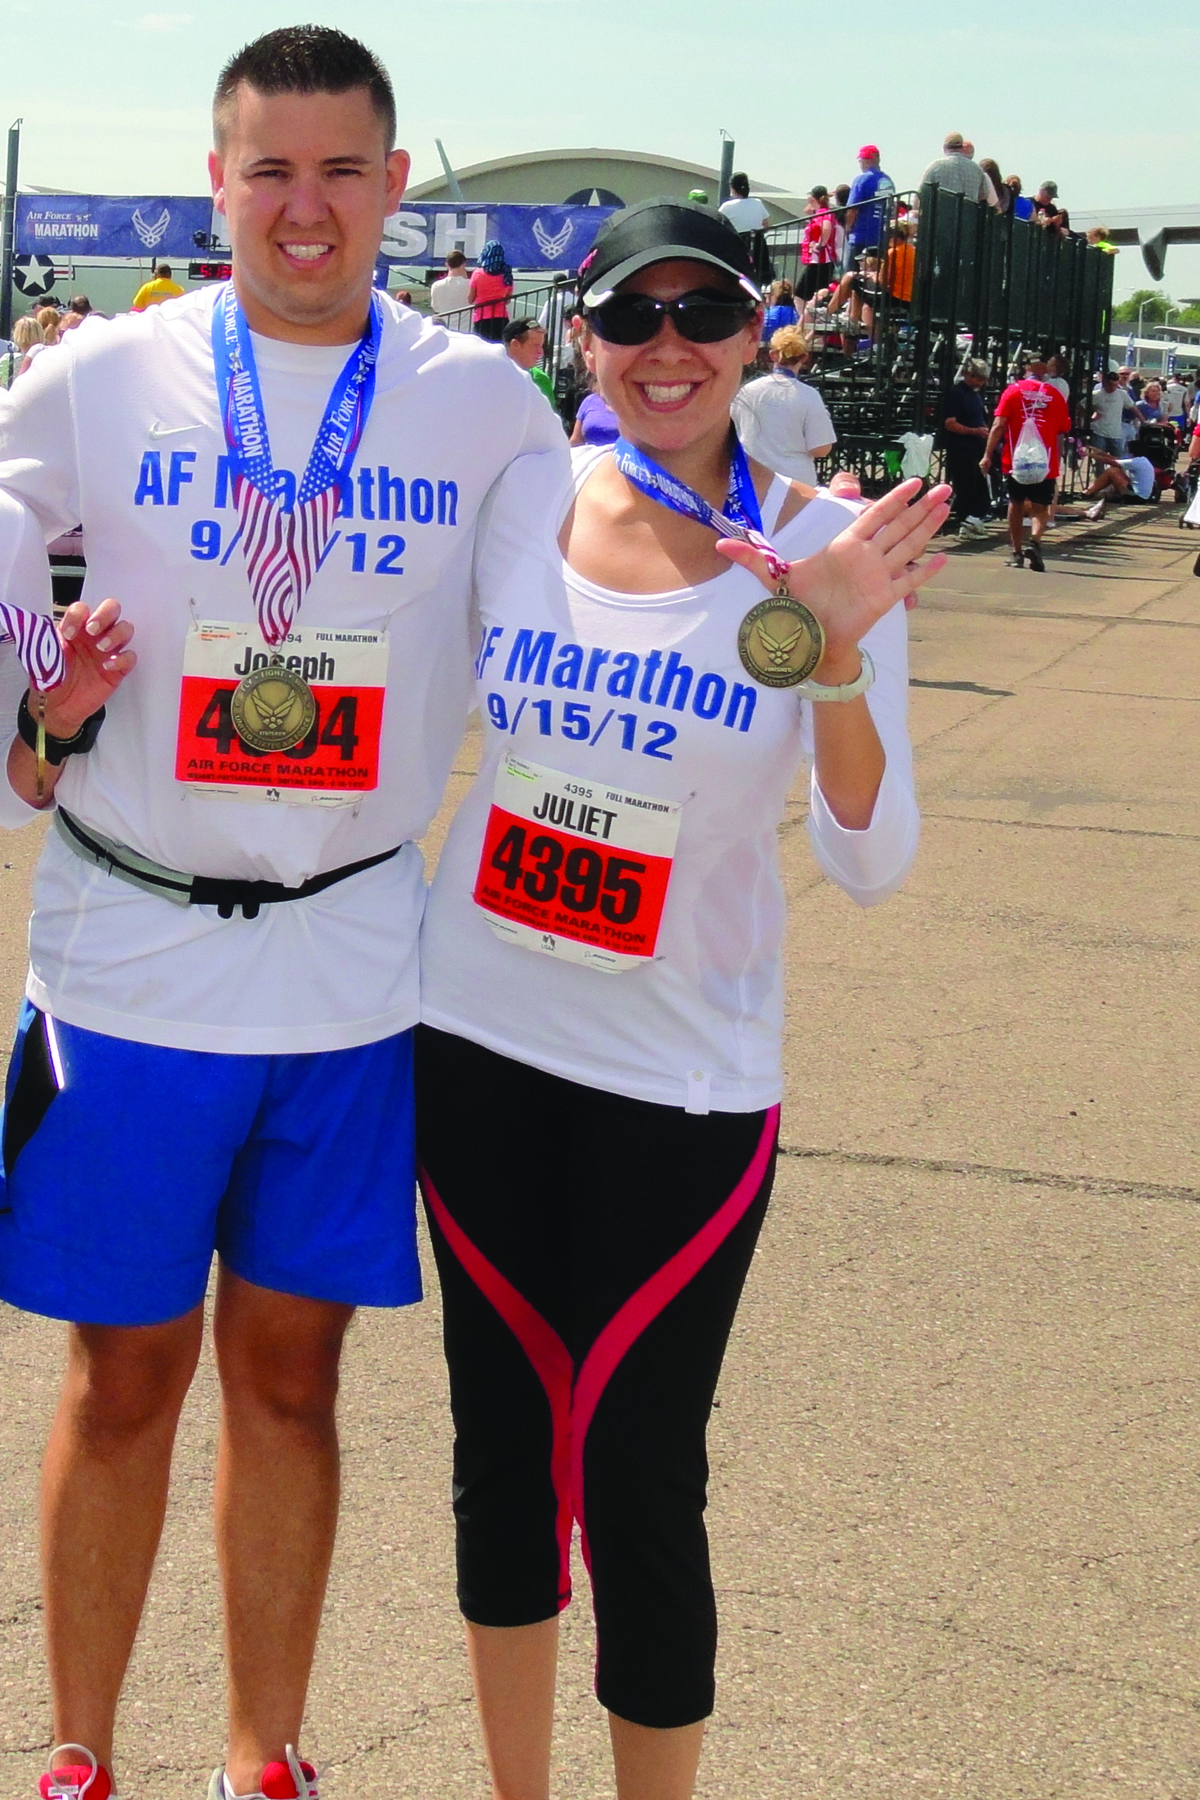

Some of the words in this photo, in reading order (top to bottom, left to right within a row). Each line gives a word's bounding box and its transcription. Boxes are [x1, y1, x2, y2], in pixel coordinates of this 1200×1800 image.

[27, 211, 42, 221] AIR
[44, 211, 71, 221] FORCE
[34, 223, 98, 237] MARATHON
[224, 301, 239, 346] FORCE
[232, 369, 264, 459] MARATHON
[327, 385, 361, 433] FORCE
[321, 433, 344, 466] AIR
[133, 450, 197, 506] AF
[213, 454, 458, 526] Mathon
[189, 519, 407, 576] 9//12
[764, 599, 792, 609] FIGHT
[316, 632, 334, 642] FULL
[335, 633, 378, 644] MARATHON
[260, 669, 286, 678] FIGHT
[503, 627, 758, 733] Marathon
[195, 688, 359, 761] 44
[486, 692, 678, 762] 9/15/12
[186, 758, 214, 770] AIR
[219, 761, 271, 774] FORCE
[276, 764, 369, 778] MARATHON
[532, 792, 618, 839] JULIET
[563, 782, 594, 799] 4395
[605, 791, 623, 803] FULL
[624, 796, 670, 813] MARATHON
[491, 824, 647, 925] 4395
[481, 885, 502, 900] AIR
[505, 896, 550, 919] FORCE
[554, 913, 647, 944] MARATHON
